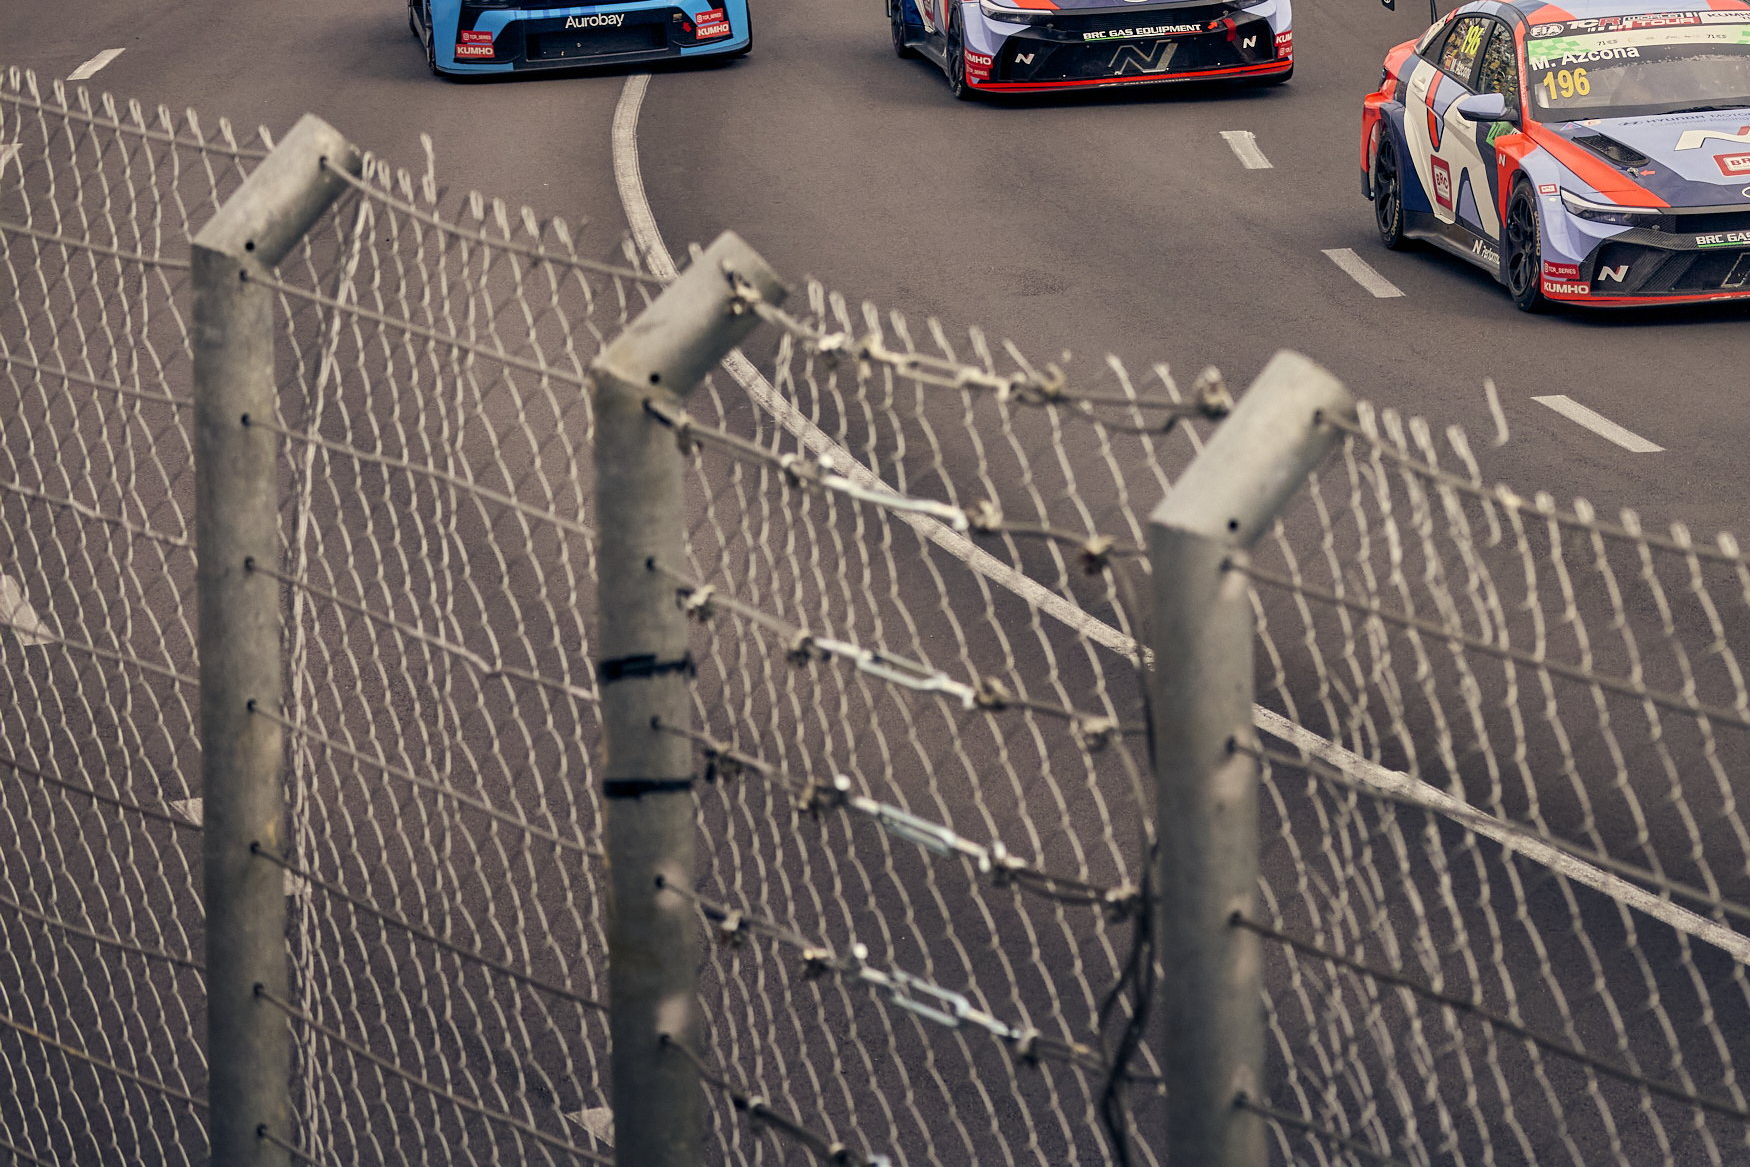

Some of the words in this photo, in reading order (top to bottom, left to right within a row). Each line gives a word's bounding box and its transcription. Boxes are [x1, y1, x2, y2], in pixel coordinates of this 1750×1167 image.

[565, 13, 625, 29] Aurobay
[1531, 25, 1565, 36] FIA
[1567, 17, 1621, 30] TCR
[1641, 17, 1698, 26] TOUR
[698, 23, 729, 36] KUMHO
[1083, 31, 1107, 40] BRC
[1108, 28, 1133, 38] GAS
[1135, 24, 1201, 36] EQUIPMENT
[1460, 24, 1485, 55] 196
[457, 46, 493, 55] KUMHO
[1531, 56, 1556, 71] M.
[1561, 46, 1640, 66] Azcona
[1543, 67, 1590, 99] 196
[1435, 169, 1449, 191] BRC
[1696, 235, 1724, 246] BRC
[1544, 283, 1590, 294] KUMHO
